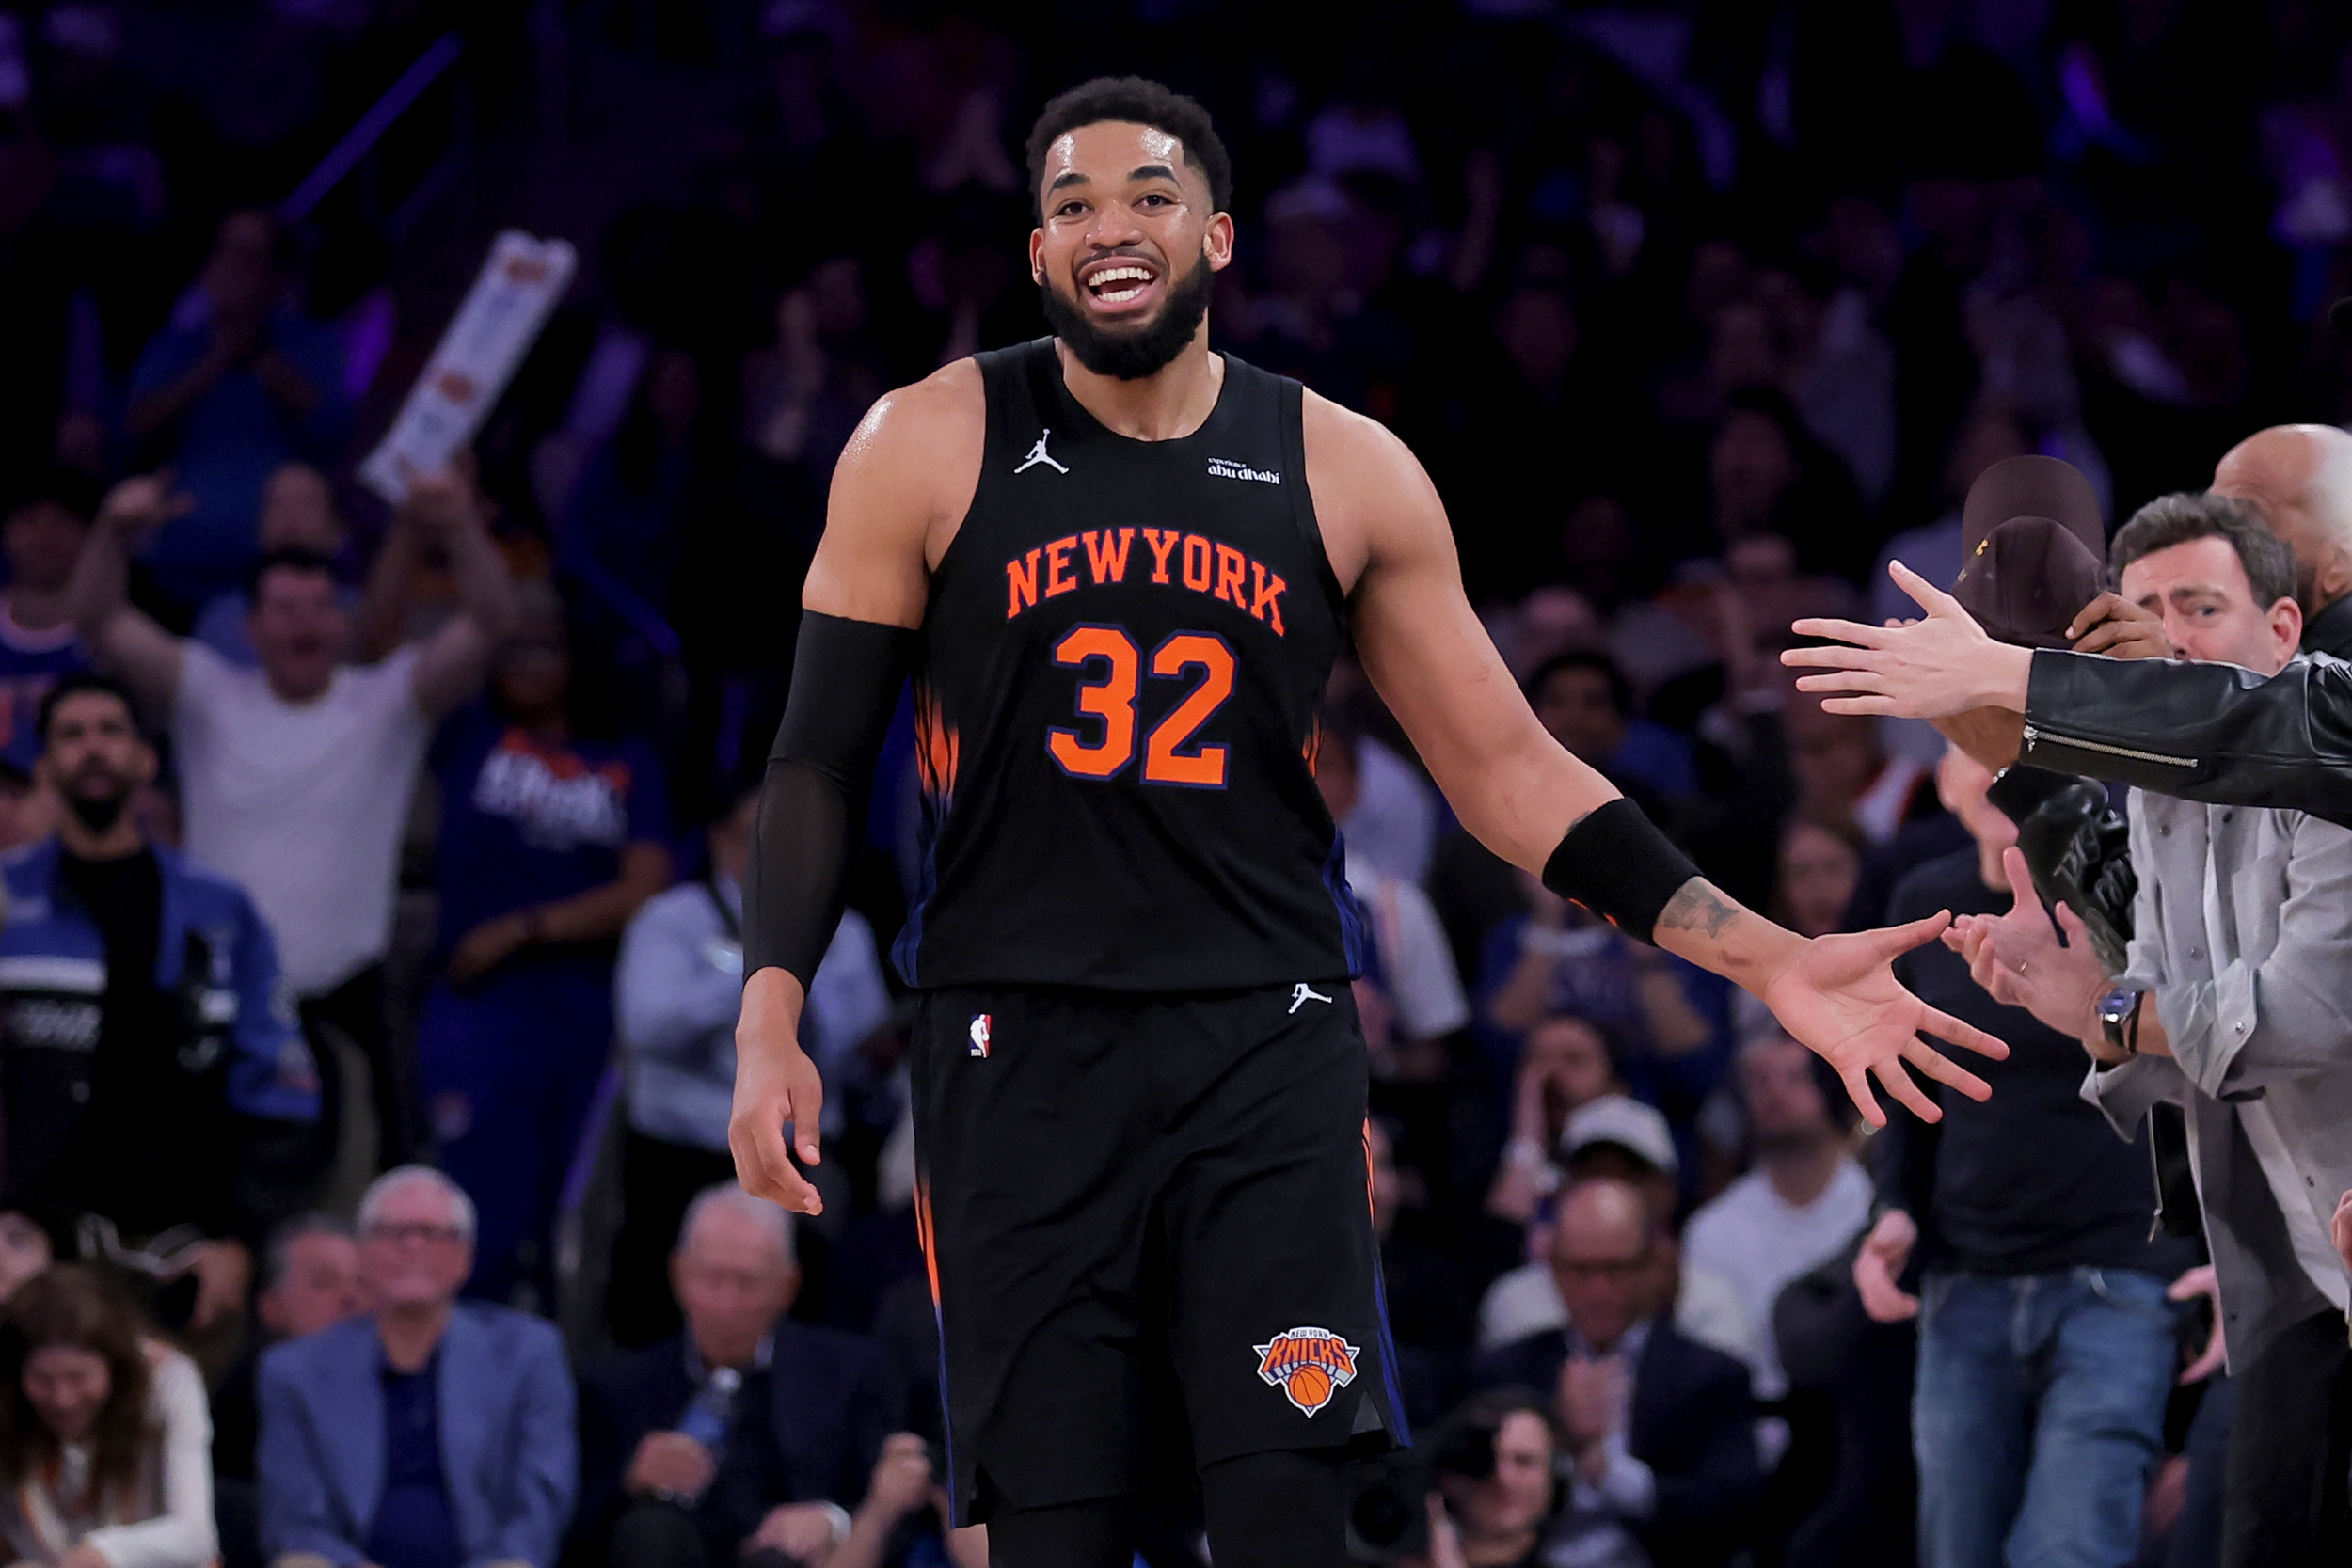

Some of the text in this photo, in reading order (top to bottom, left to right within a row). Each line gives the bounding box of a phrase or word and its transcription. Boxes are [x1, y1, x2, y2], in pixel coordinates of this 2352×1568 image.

[1208, 465, 1280, 484] abu dhabi
[1005, 526, 1287, 638] NEW YORK
[1045, 623, 1238, 788] 32
[1290, 1329, 1329, 1338] NEW YORK
[1261, 1336, 1354, 1375] KNICKS
